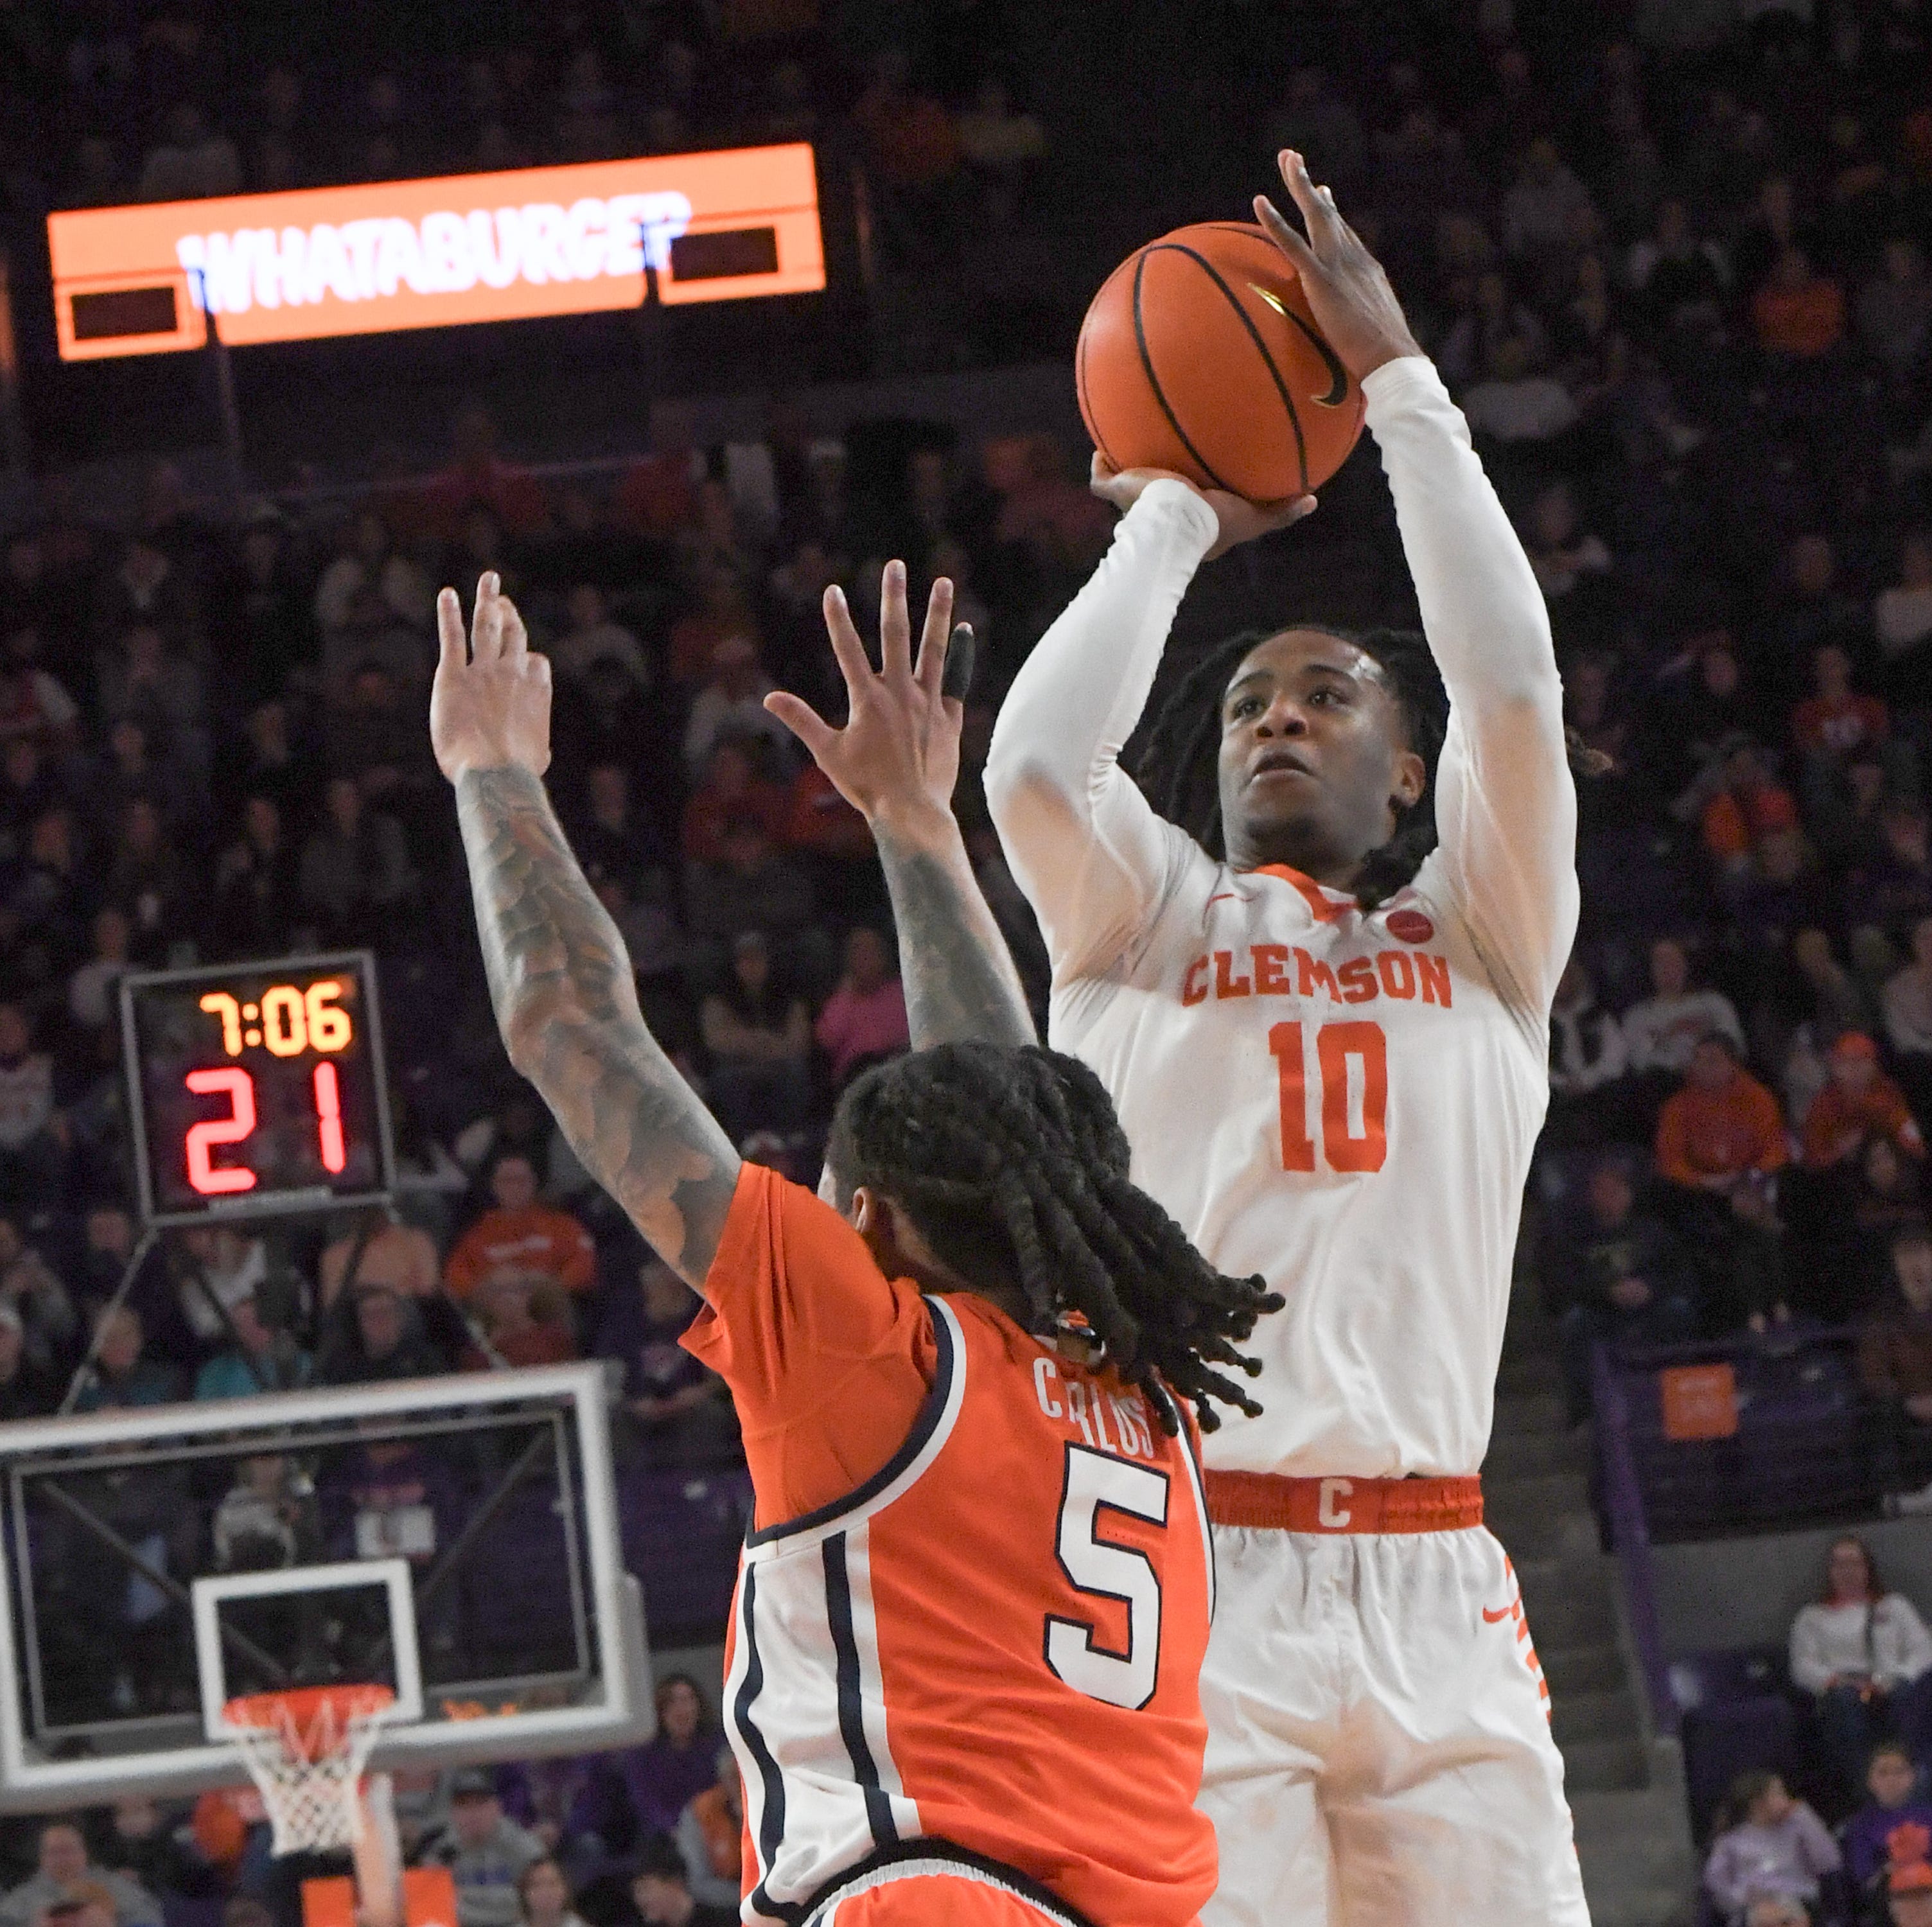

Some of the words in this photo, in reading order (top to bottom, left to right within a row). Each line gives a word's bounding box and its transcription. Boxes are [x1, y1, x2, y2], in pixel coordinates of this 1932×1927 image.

[1182, 944, 1452, 1009] CLEMSON
[199, 981, 353, 1057] 7:06
[1269, 1021, 1388, 1174] 10
[1318, 1479, 1353, 1528] C
[1042, 1439, 1171, 1711] 5
